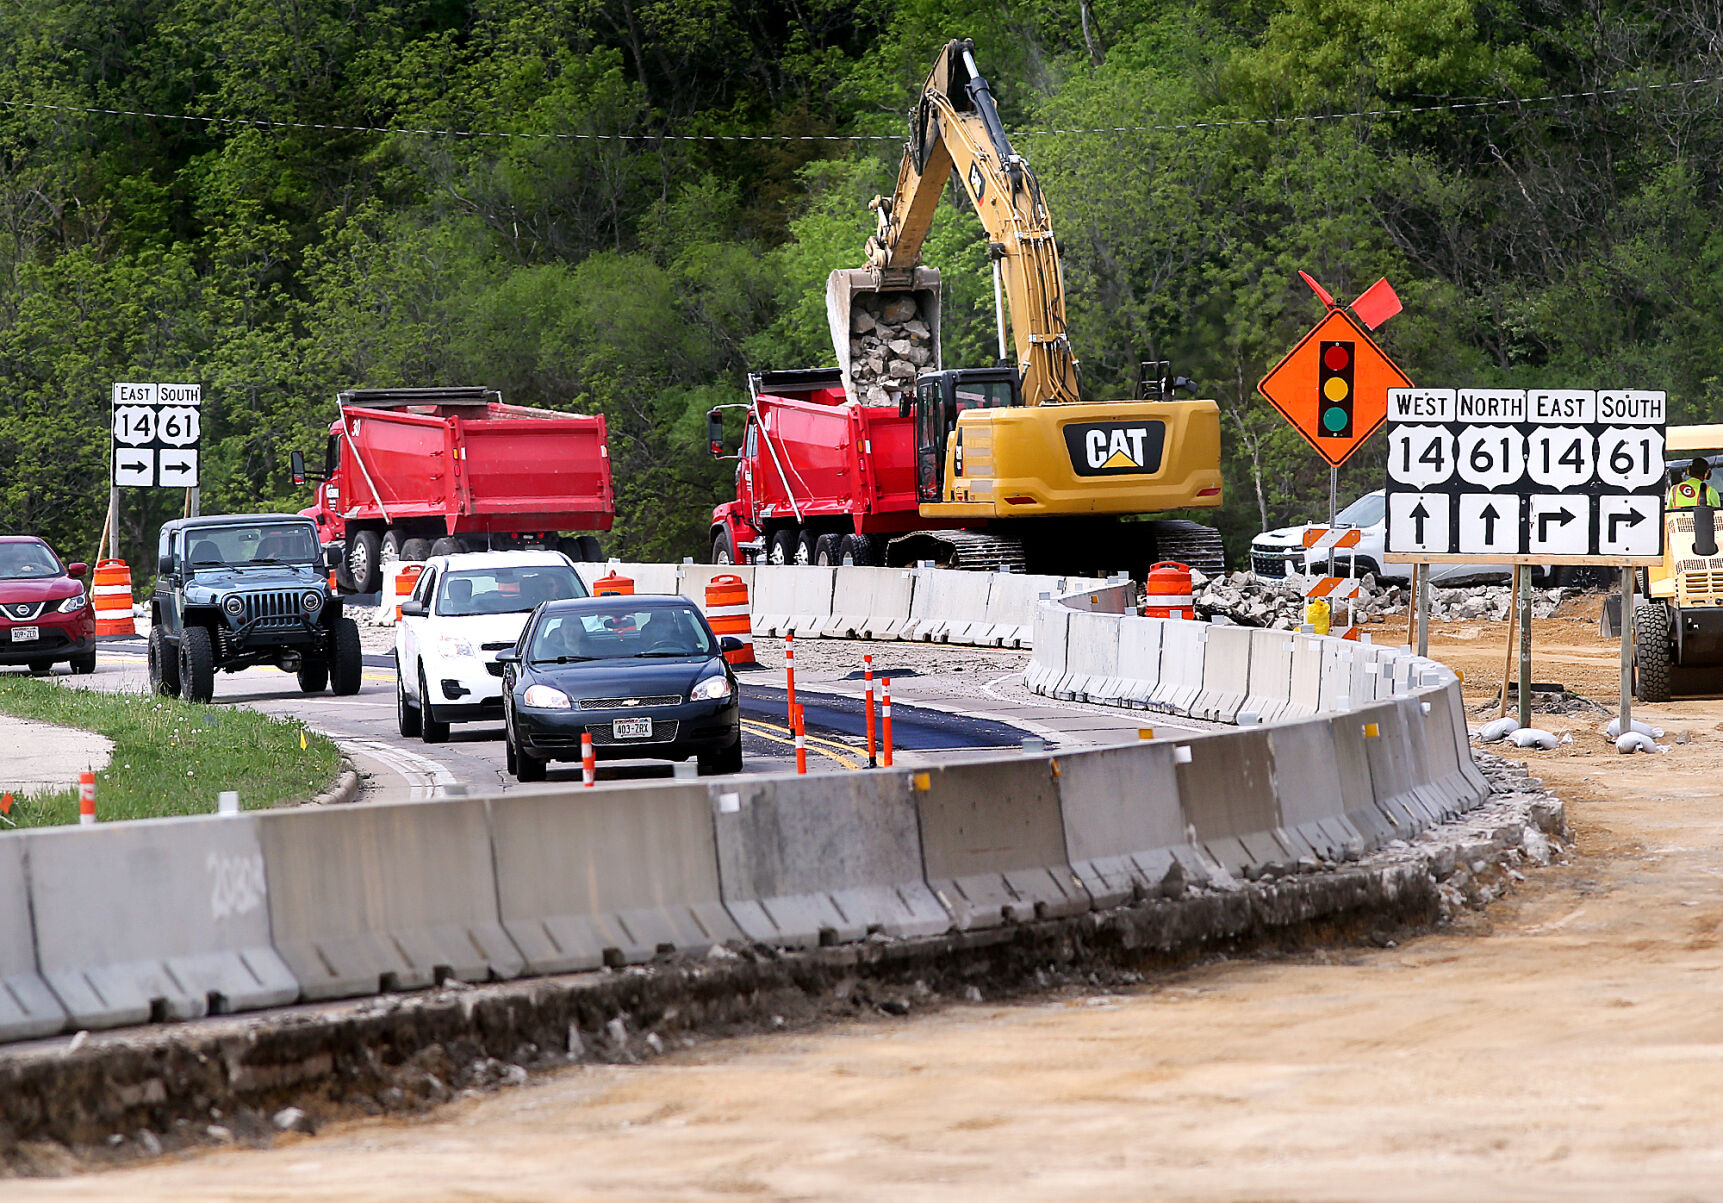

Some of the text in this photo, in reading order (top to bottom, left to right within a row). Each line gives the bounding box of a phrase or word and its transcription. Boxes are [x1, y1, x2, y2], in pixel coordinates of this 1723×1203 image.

[121, 387, 150, 400] EAST
[161, 387, 198, 401] SOUTH
[1396, 394, 1447, 416] WEST
[1460, 395, 1522, 417] NORTH
[1537, 396, 1585, 417] EAST
[1602, 396, 1661, 418] SOUTH
[122, 414, 150, 436] 14
[166, 414, 191, 437] 61
[1086, 428, 1147, 468] CAT
[1400, 436, 1445, 472] 14
[1470, 437, 1509, 473] 61
[1540, 438, 1584, 473] 14
[1609, 439, 1649, 474] 61
[1682, 486, 1692, 496] G
